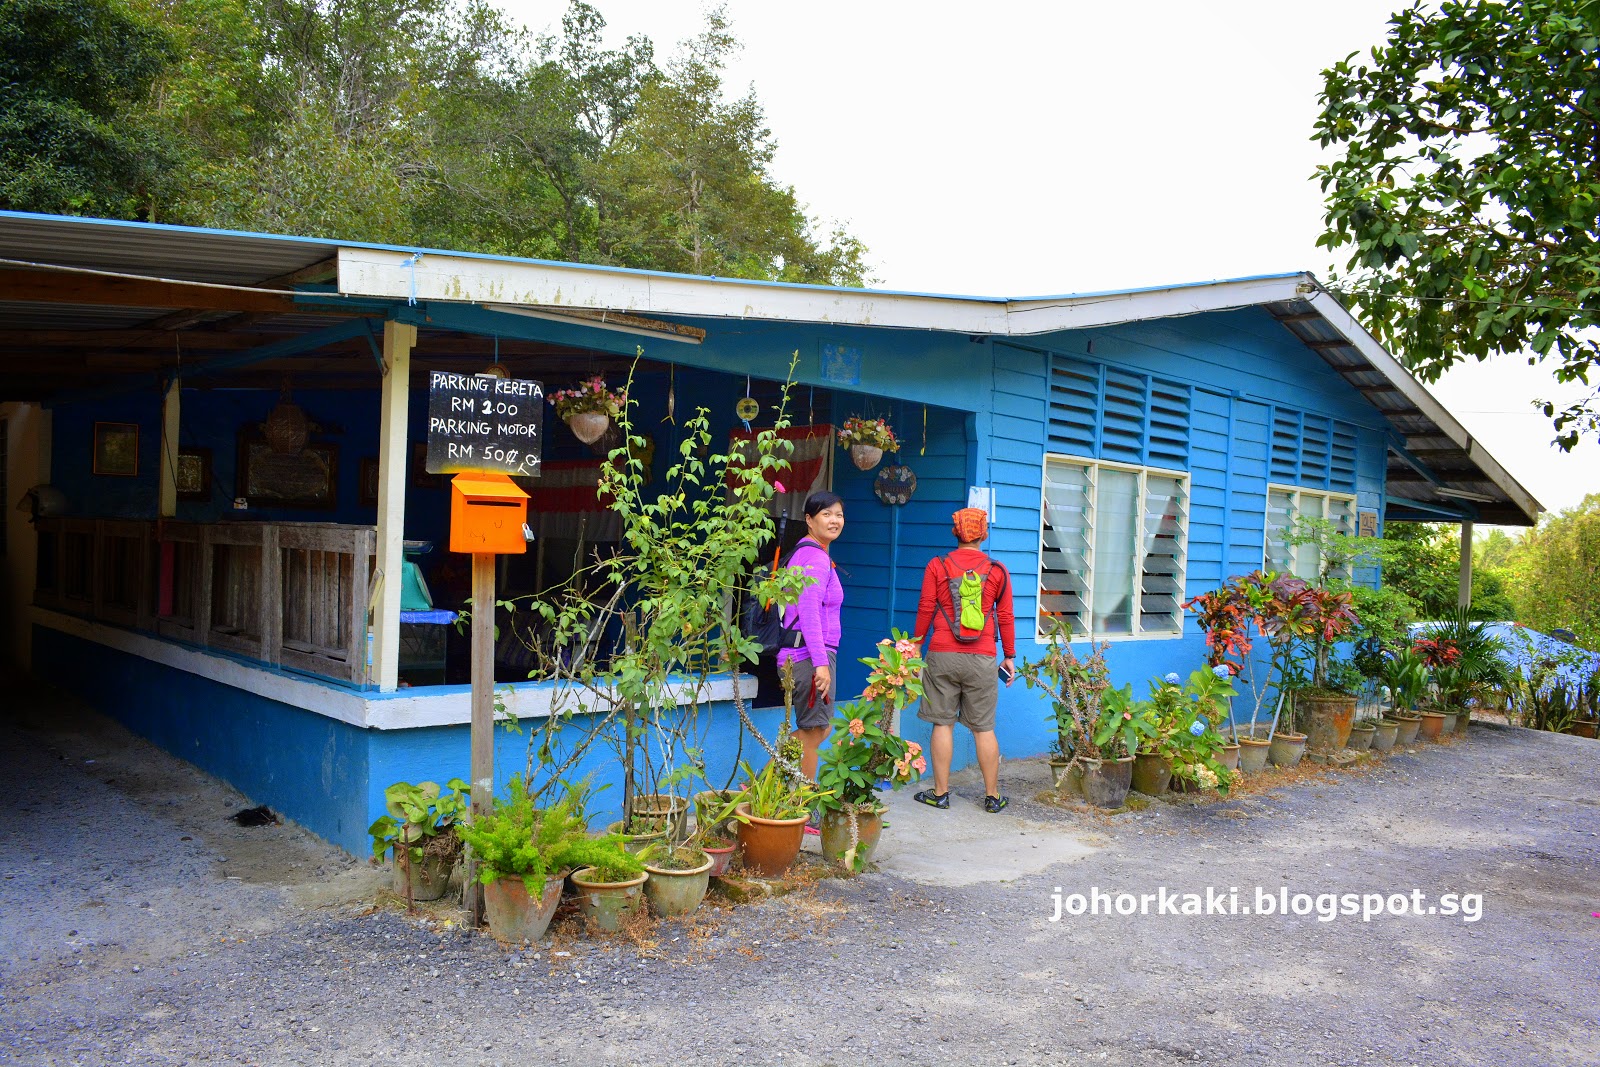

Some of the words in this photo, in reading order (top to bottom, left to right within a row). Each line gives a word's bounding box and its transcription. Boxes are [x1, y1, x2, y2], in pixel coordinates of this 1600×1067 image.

[432, 373, 489, 391] PARKING
[495, 380, 544, 398] KERETA
[451, 396, 475, 413] RM
[430, 417, 492, 435] PARKING
[497, 423, 537, 438] MOTOR
[448, 442, 473, 459] RM
